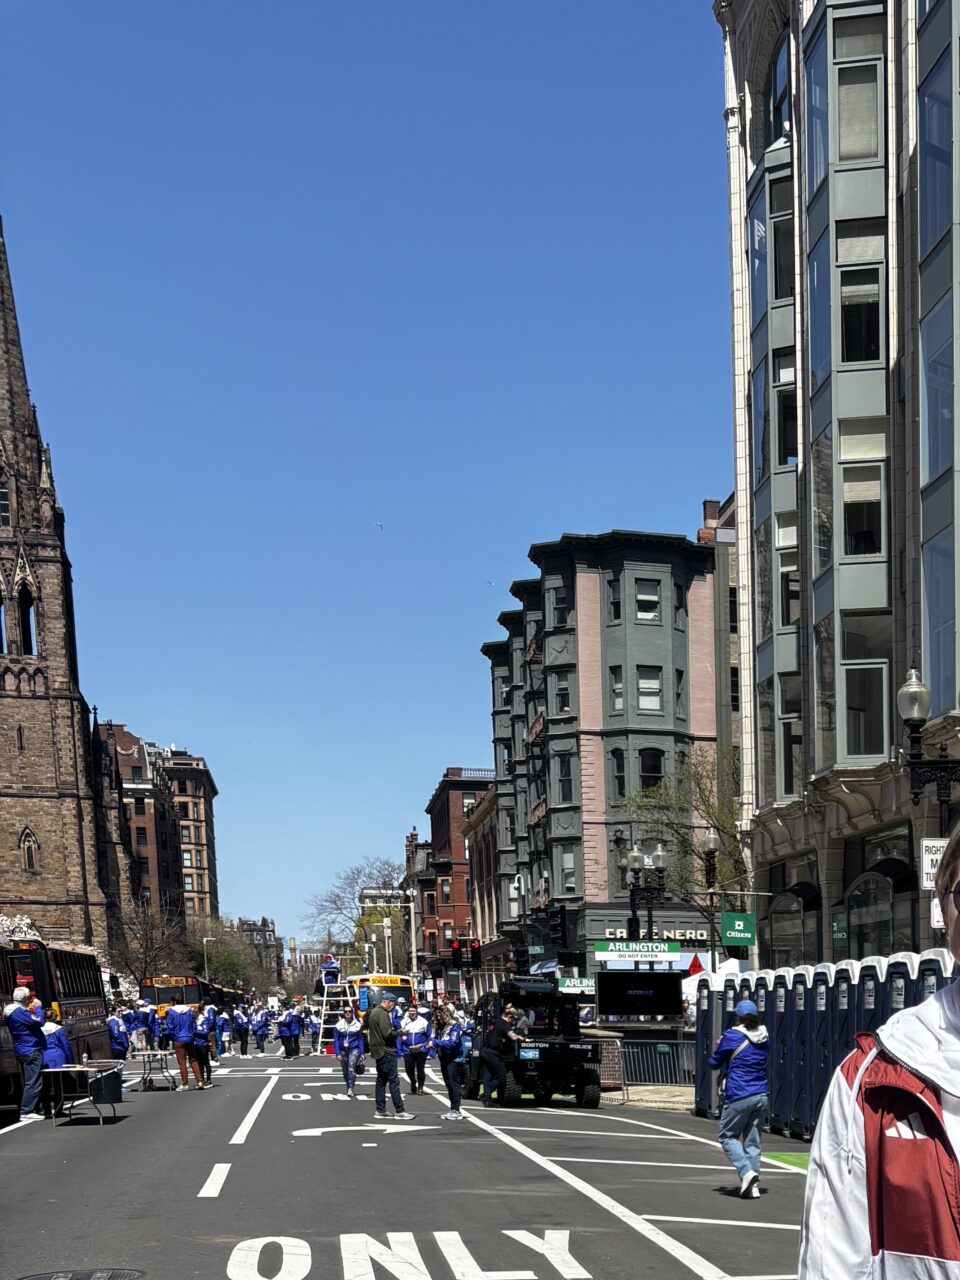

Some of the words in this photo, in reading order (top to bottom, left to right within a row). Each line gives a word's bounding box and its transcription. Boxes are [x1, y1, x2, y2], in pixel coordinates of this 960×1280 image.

[924, 845, 945, 855] RIGHT
[663, 929, 707, 940] NERO
[726, 931, 752, 939] Citizens
[608, 942, 669, 952] ARLINGTON
